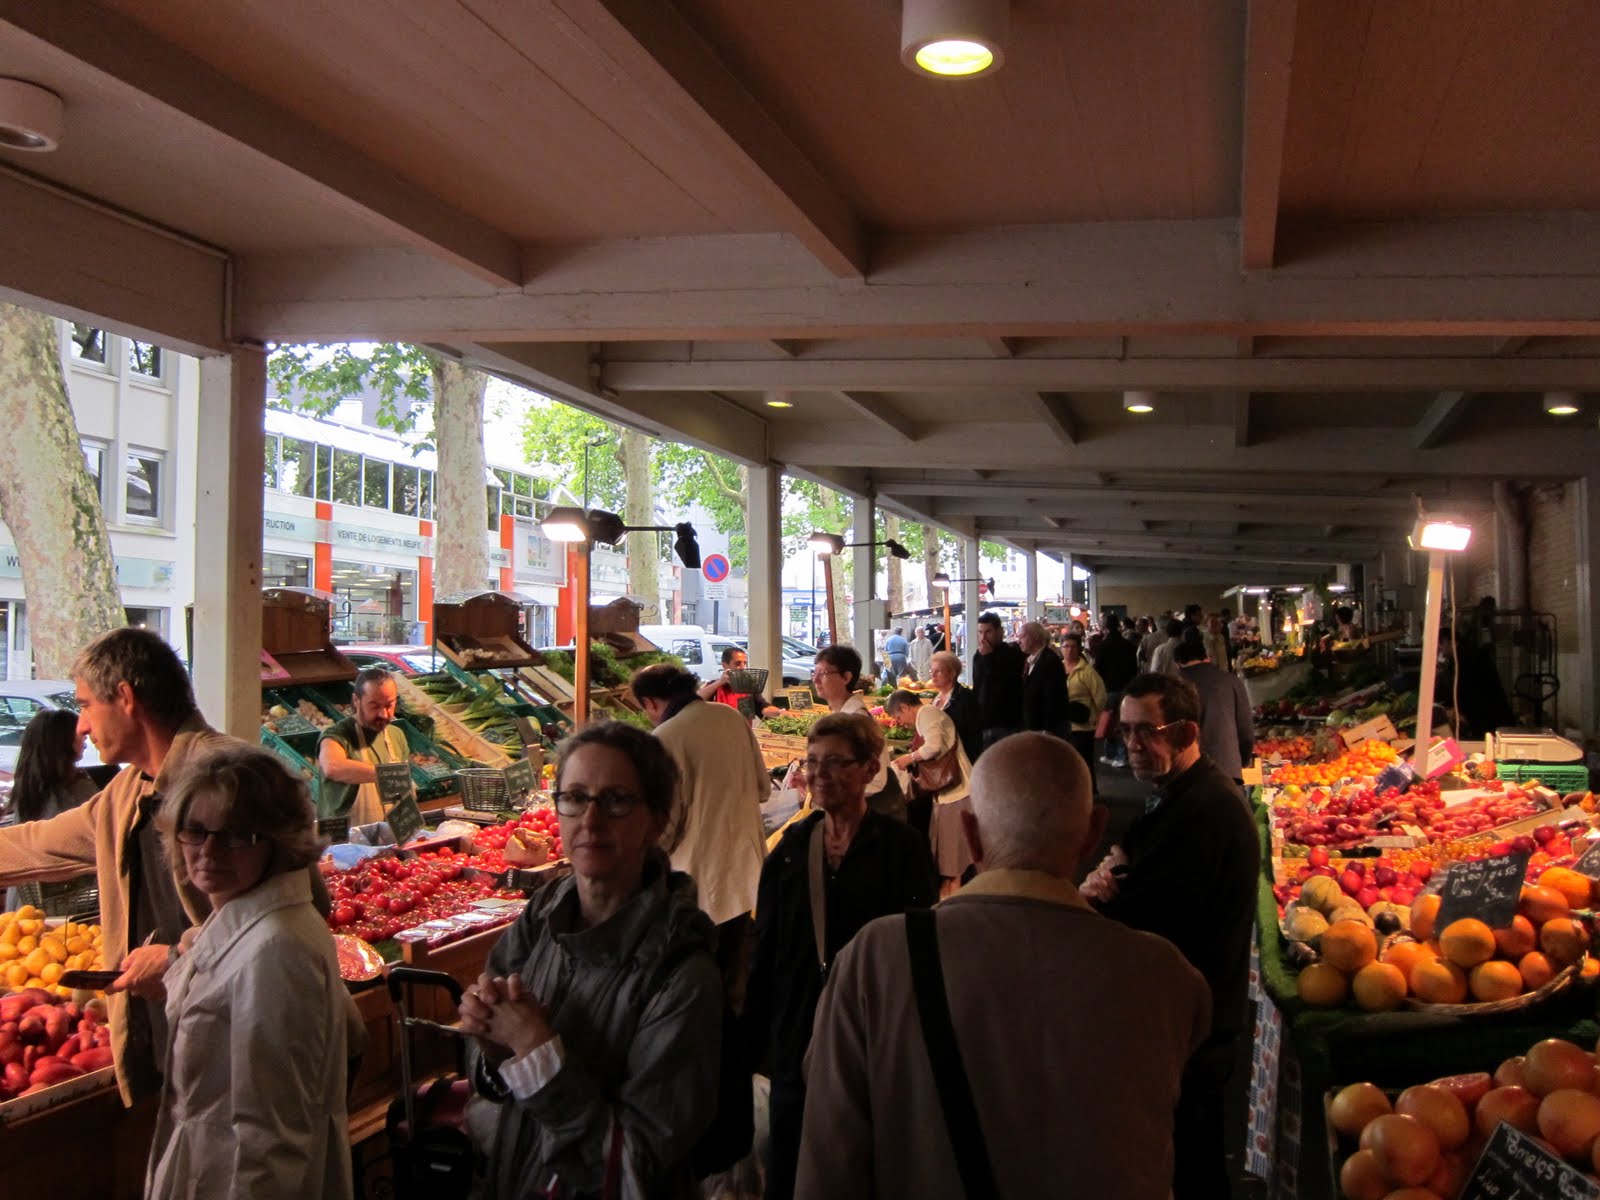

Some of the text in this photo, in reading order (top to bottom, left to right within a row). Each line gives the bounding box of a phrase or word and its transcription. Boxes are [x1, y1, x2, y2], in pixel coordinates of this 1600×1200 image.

[337, 529, 421, 550] VENTE DE LOGEMENTS NEUFS
